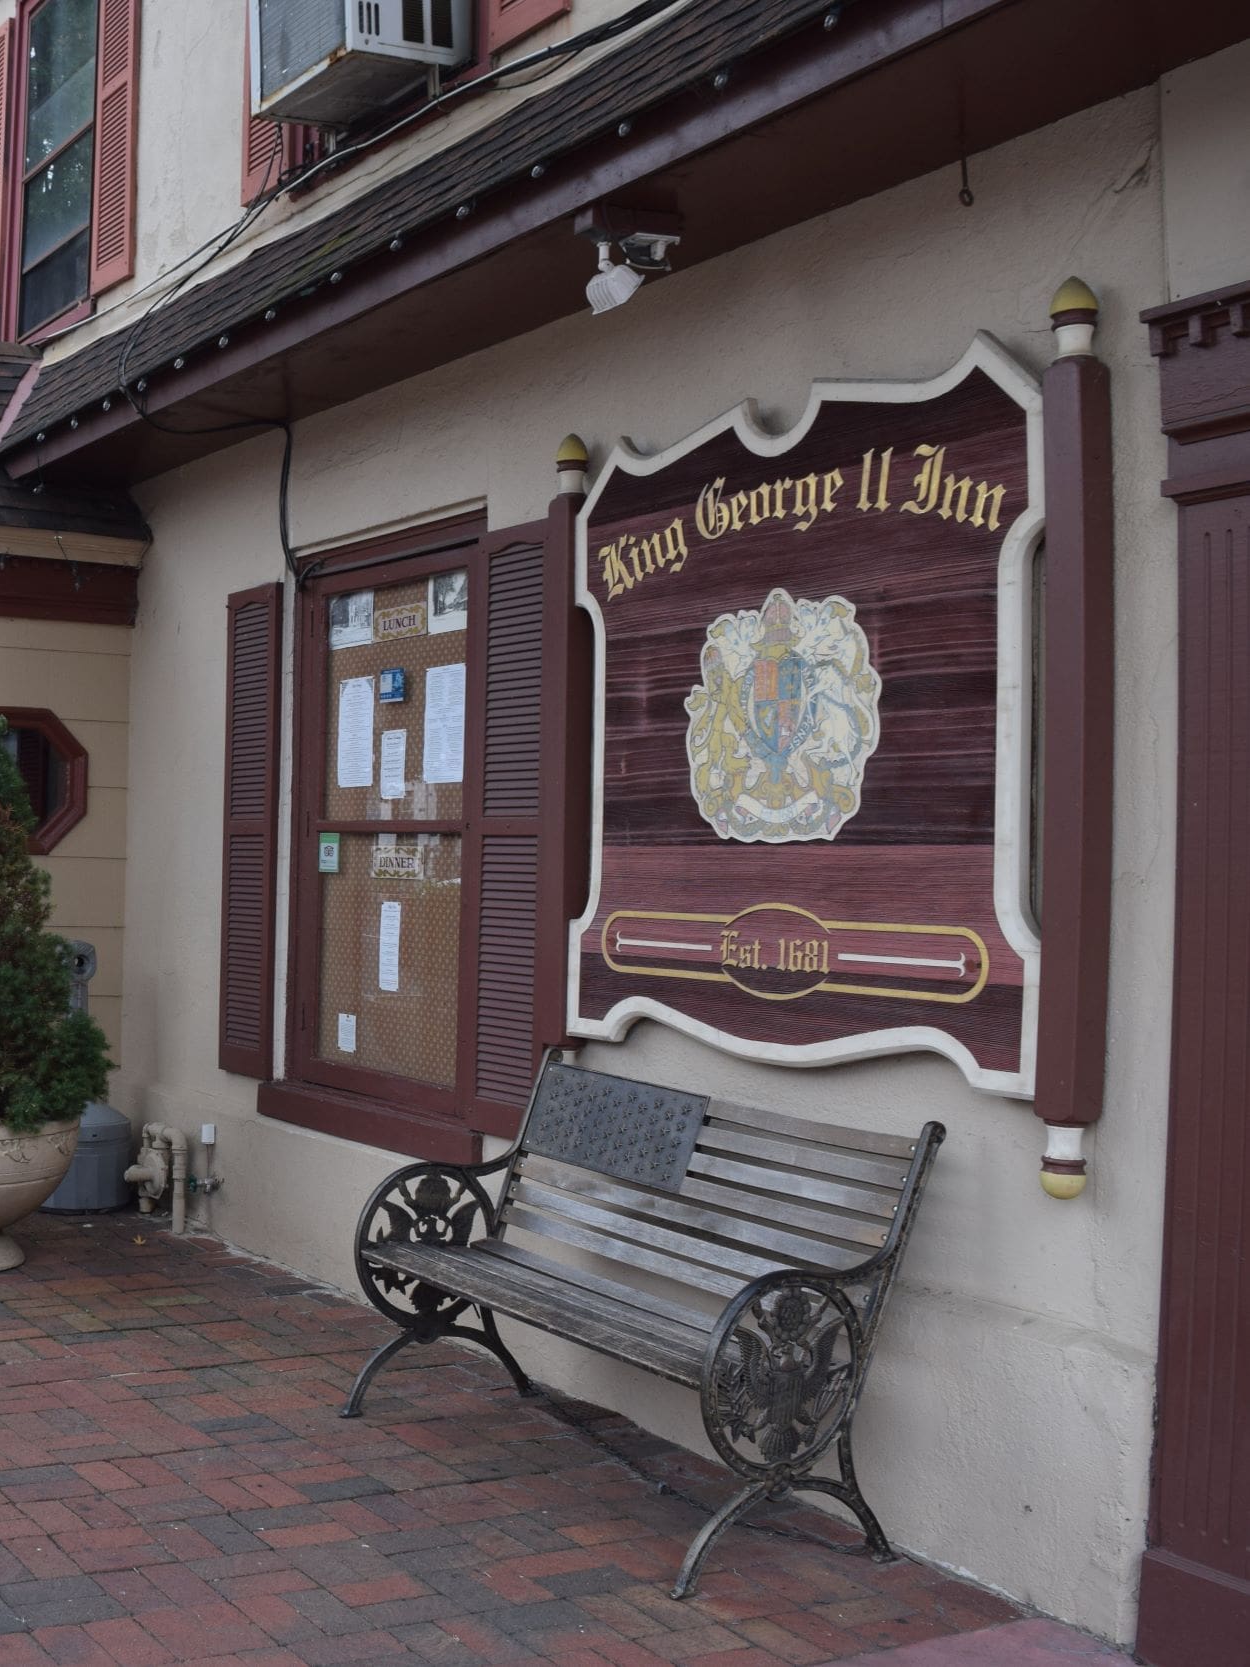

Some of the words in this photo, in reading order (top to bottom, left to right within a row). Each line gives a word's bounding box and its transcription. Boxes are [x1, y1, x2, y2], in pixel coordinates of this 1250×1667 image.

[598, 518, 688, 602] King
[695, 468, 845, 541] George
[900, 444, 1007, 532] Inn
[381, 614, 416, 631] LUNCH
[379, 856, 415, 869] DINNER
[720, 930, 768, 971] Est.
[778, 938, 831, 975] 1681
